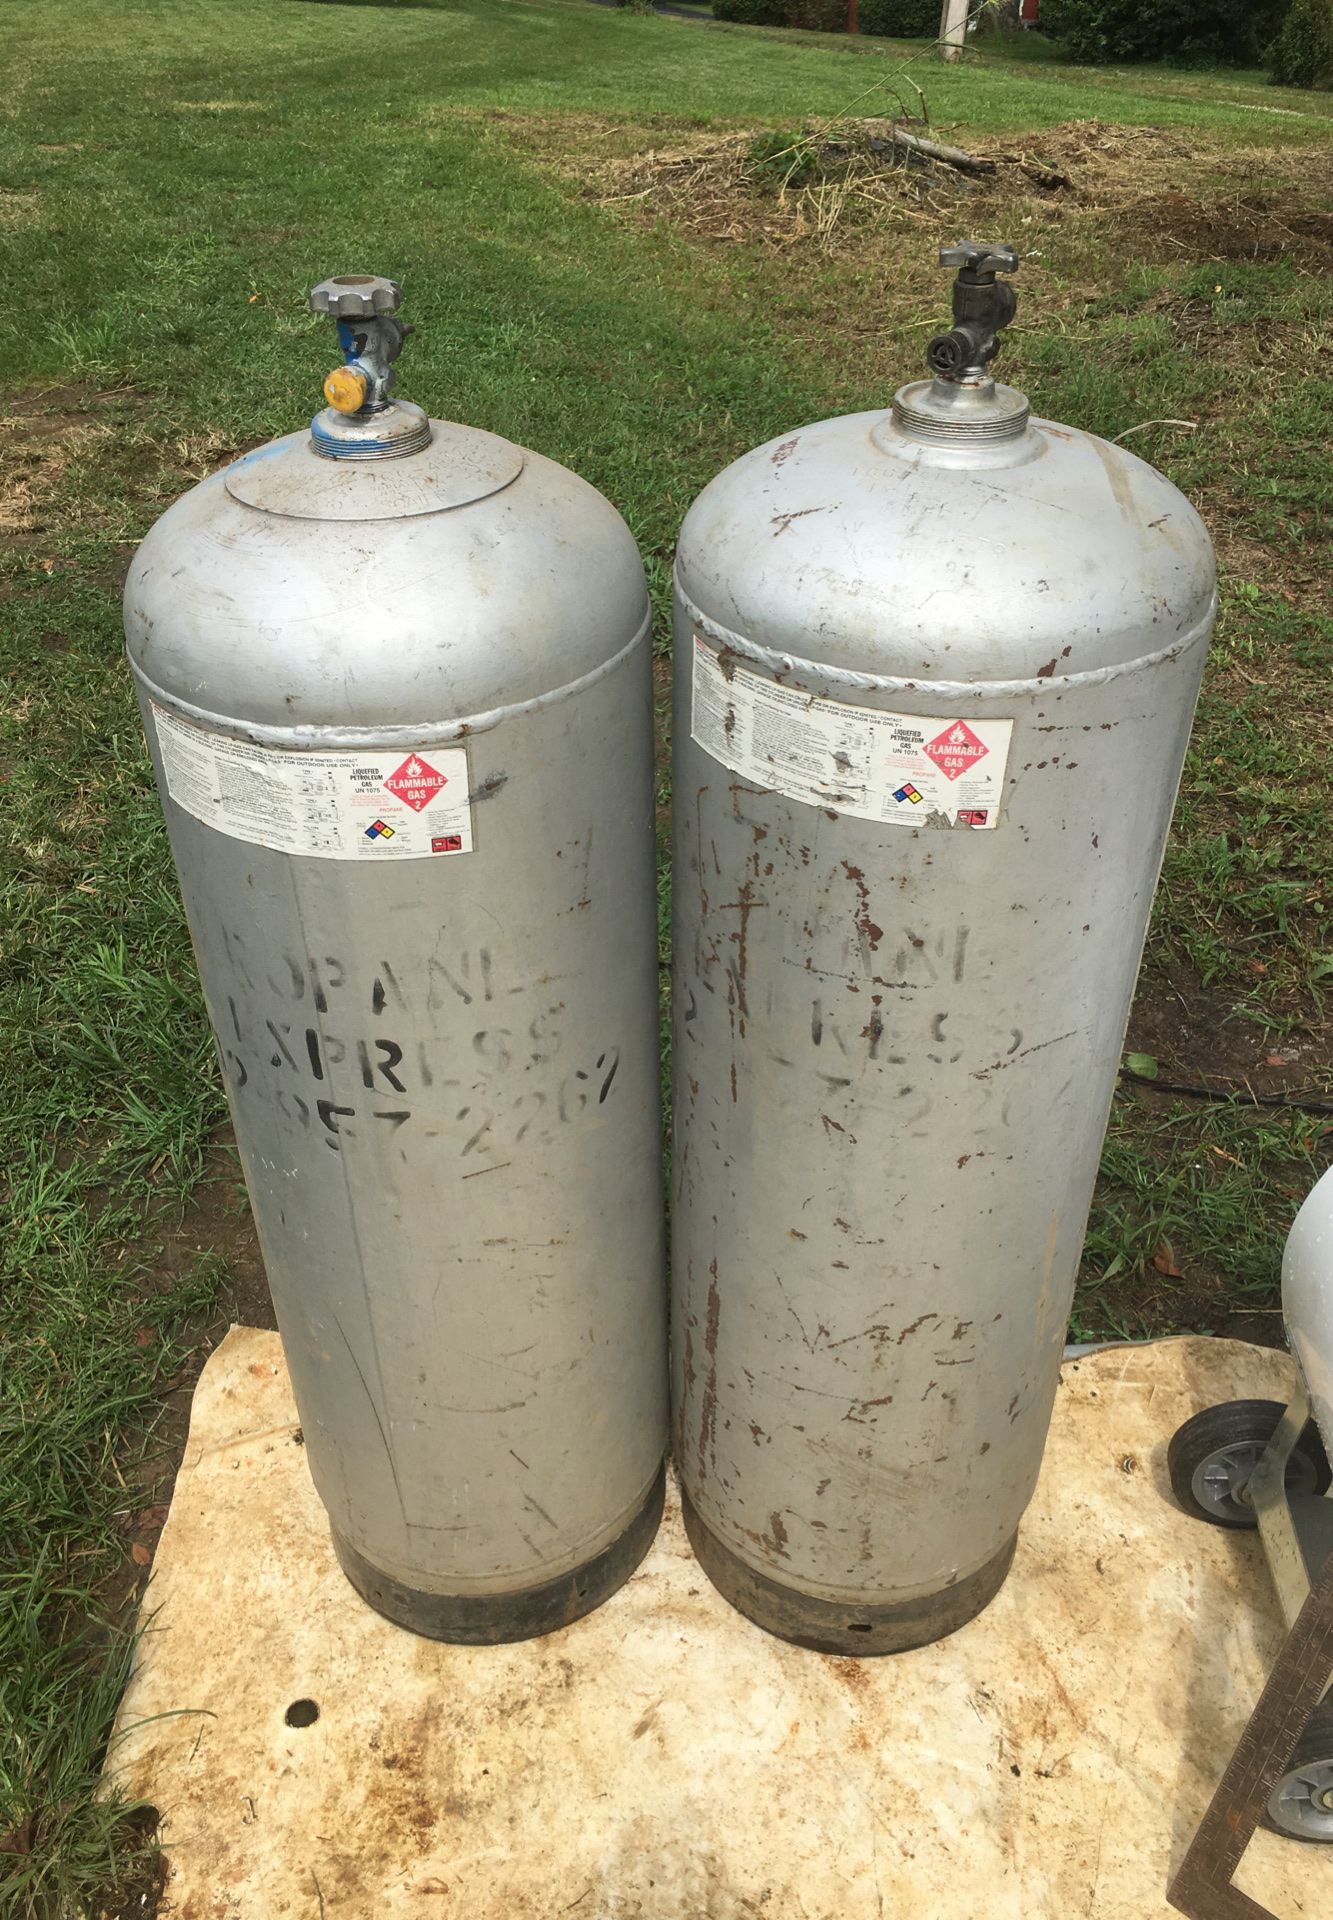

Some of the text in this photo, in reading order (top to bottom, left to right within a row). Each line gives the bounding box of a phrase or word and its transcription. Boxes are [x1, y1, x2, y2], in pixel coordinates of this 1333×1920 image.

[893, 728, 922, 738] LIQUEFIED
[890, 734, 925, 744] PETROLEUM
[926, 744, 986, 756] FLAMMABLE
[944, 757, 964, 768] GAS
[949, 768, 956, 778] 2
[387, 776, 444, 790] FLAMMABLE
[407, 789, 427, 801] GAS
[415, 800, 421, 810] 2
